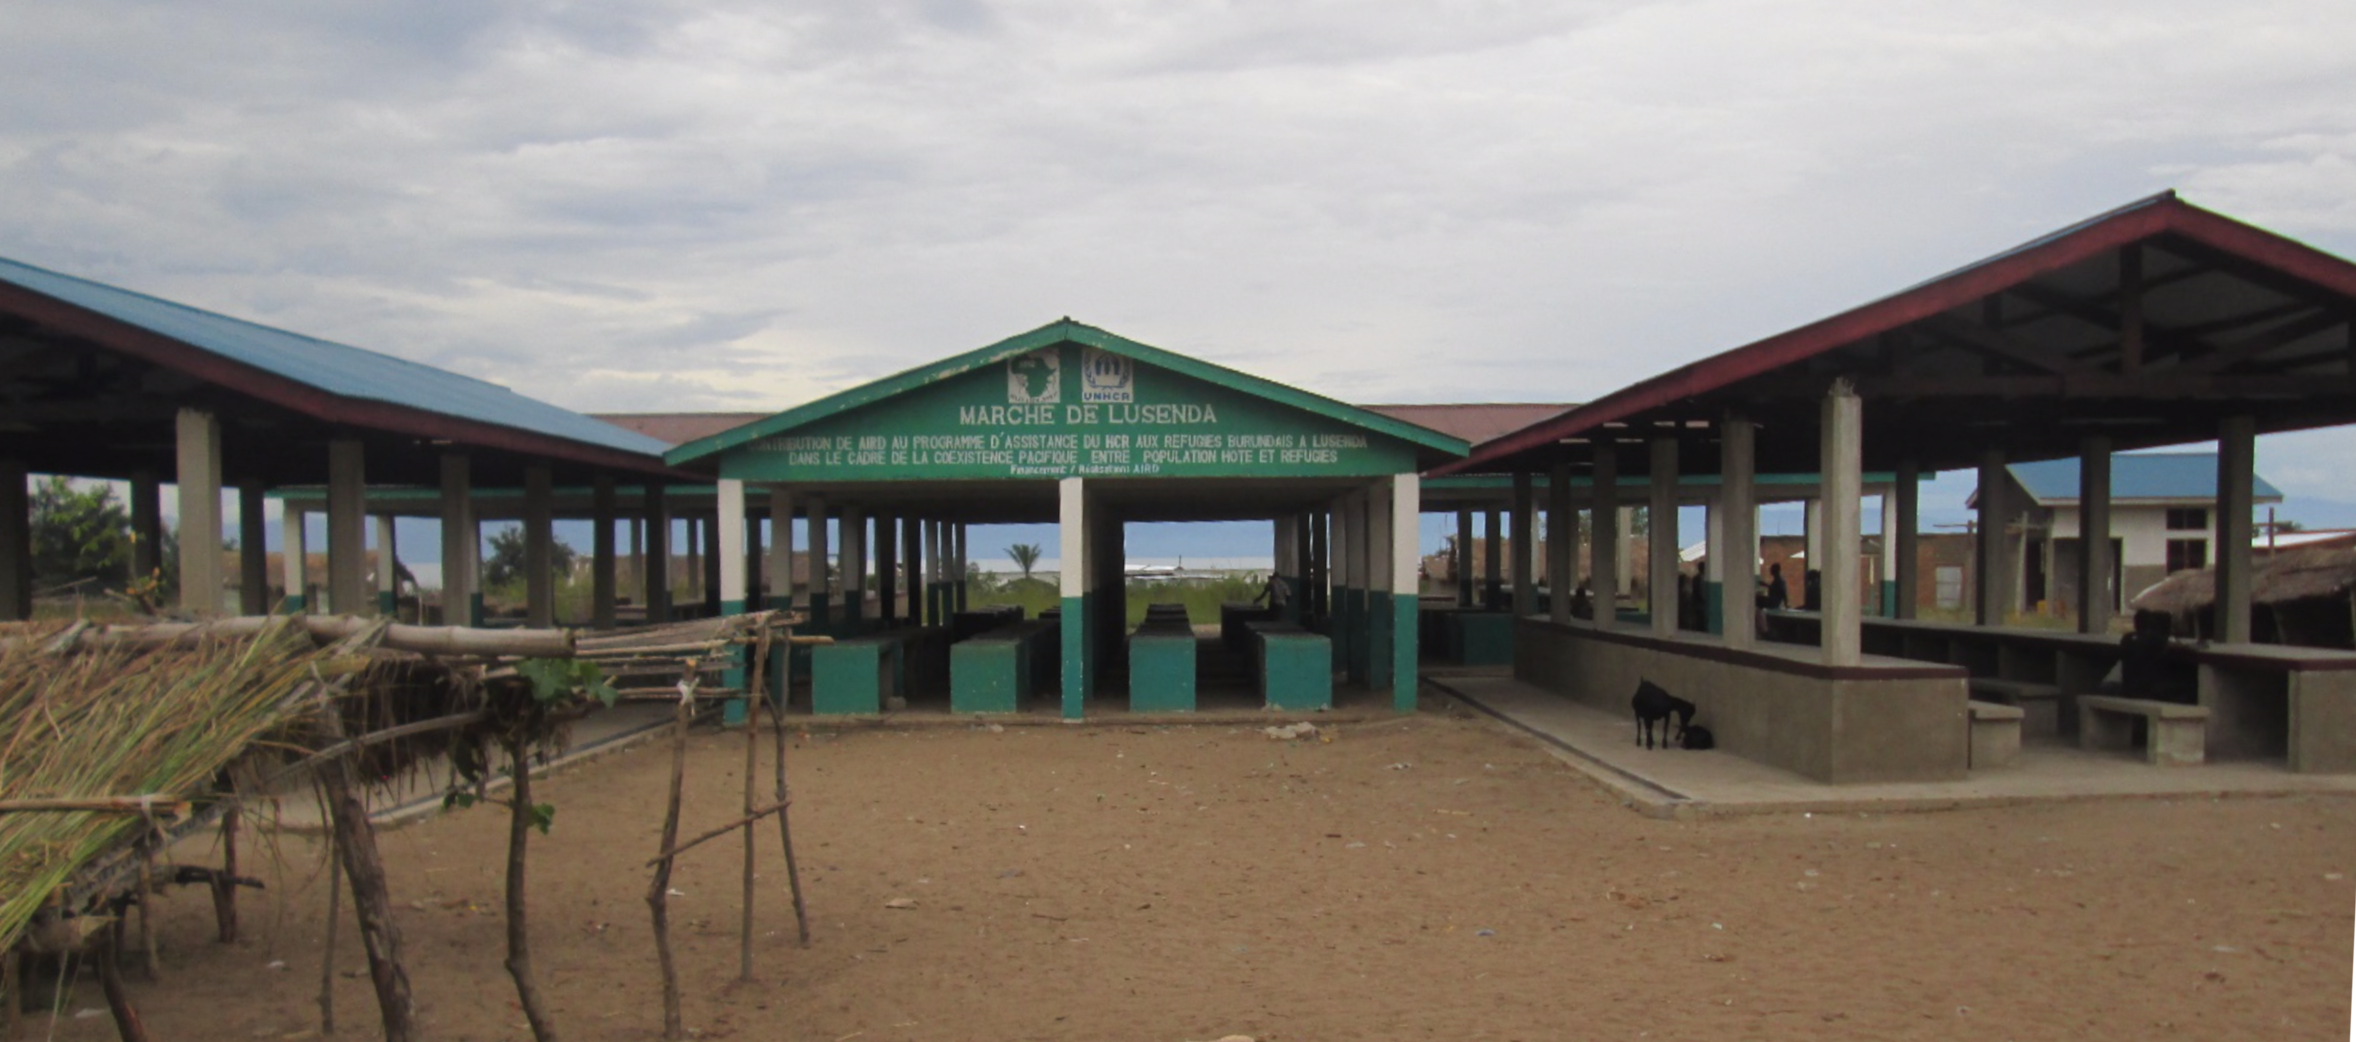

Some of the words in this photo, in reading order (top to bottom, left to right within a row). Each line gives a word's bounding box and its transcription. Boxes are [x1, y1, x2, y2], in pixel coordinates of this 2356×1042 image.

[1083, 392, 1130, 402] UNHCR
[959, 404, 1055, 425] MARCHE
[1066, 404, 1098, 424] DE
[1107, 403, 1217, 424] LUSENDA
[837, 436, 853, 450] DE
[859, 436, 886, 450] AIRD
[892, 435, 908, 449] AU
[913, 435, 985, 449] PROGRAMME
[990, 431, 1077, 449] D'ASSISTANCE
[1083, 434, 1099, 449] DU
[1105, 434, 1130, 448] HCR
[1135, 434, 1158, 448] AUX
[1164, 434, 1223, 448] REFUGIES
[1227, 434, 1294, 448] BURUNDAIS
[1312, 434, 1367, 448] LUSENDA
[789, 451, 821, 465] DANS
[826, 450, 843, 464] LE
[848, 450, 886, 464] CADRE
[891, 450, 908, 464] DE
[912, 450, 929, 464] LA
[934, 450, 1014, 464] COEXISTENCE
[1018, 449, 1077, 464] PACIFIQUE
[1091, 449, 1130, 463] ENTRE
[1143, 449, 1217, 463] POPULATION
[1221, 449, 1253, 463] HOTE
[1259, 449, 1275, 463] ET
[1280, 449, 1339, 463] REFUGIES
[1133, 464, 1160, 474] AIRD
